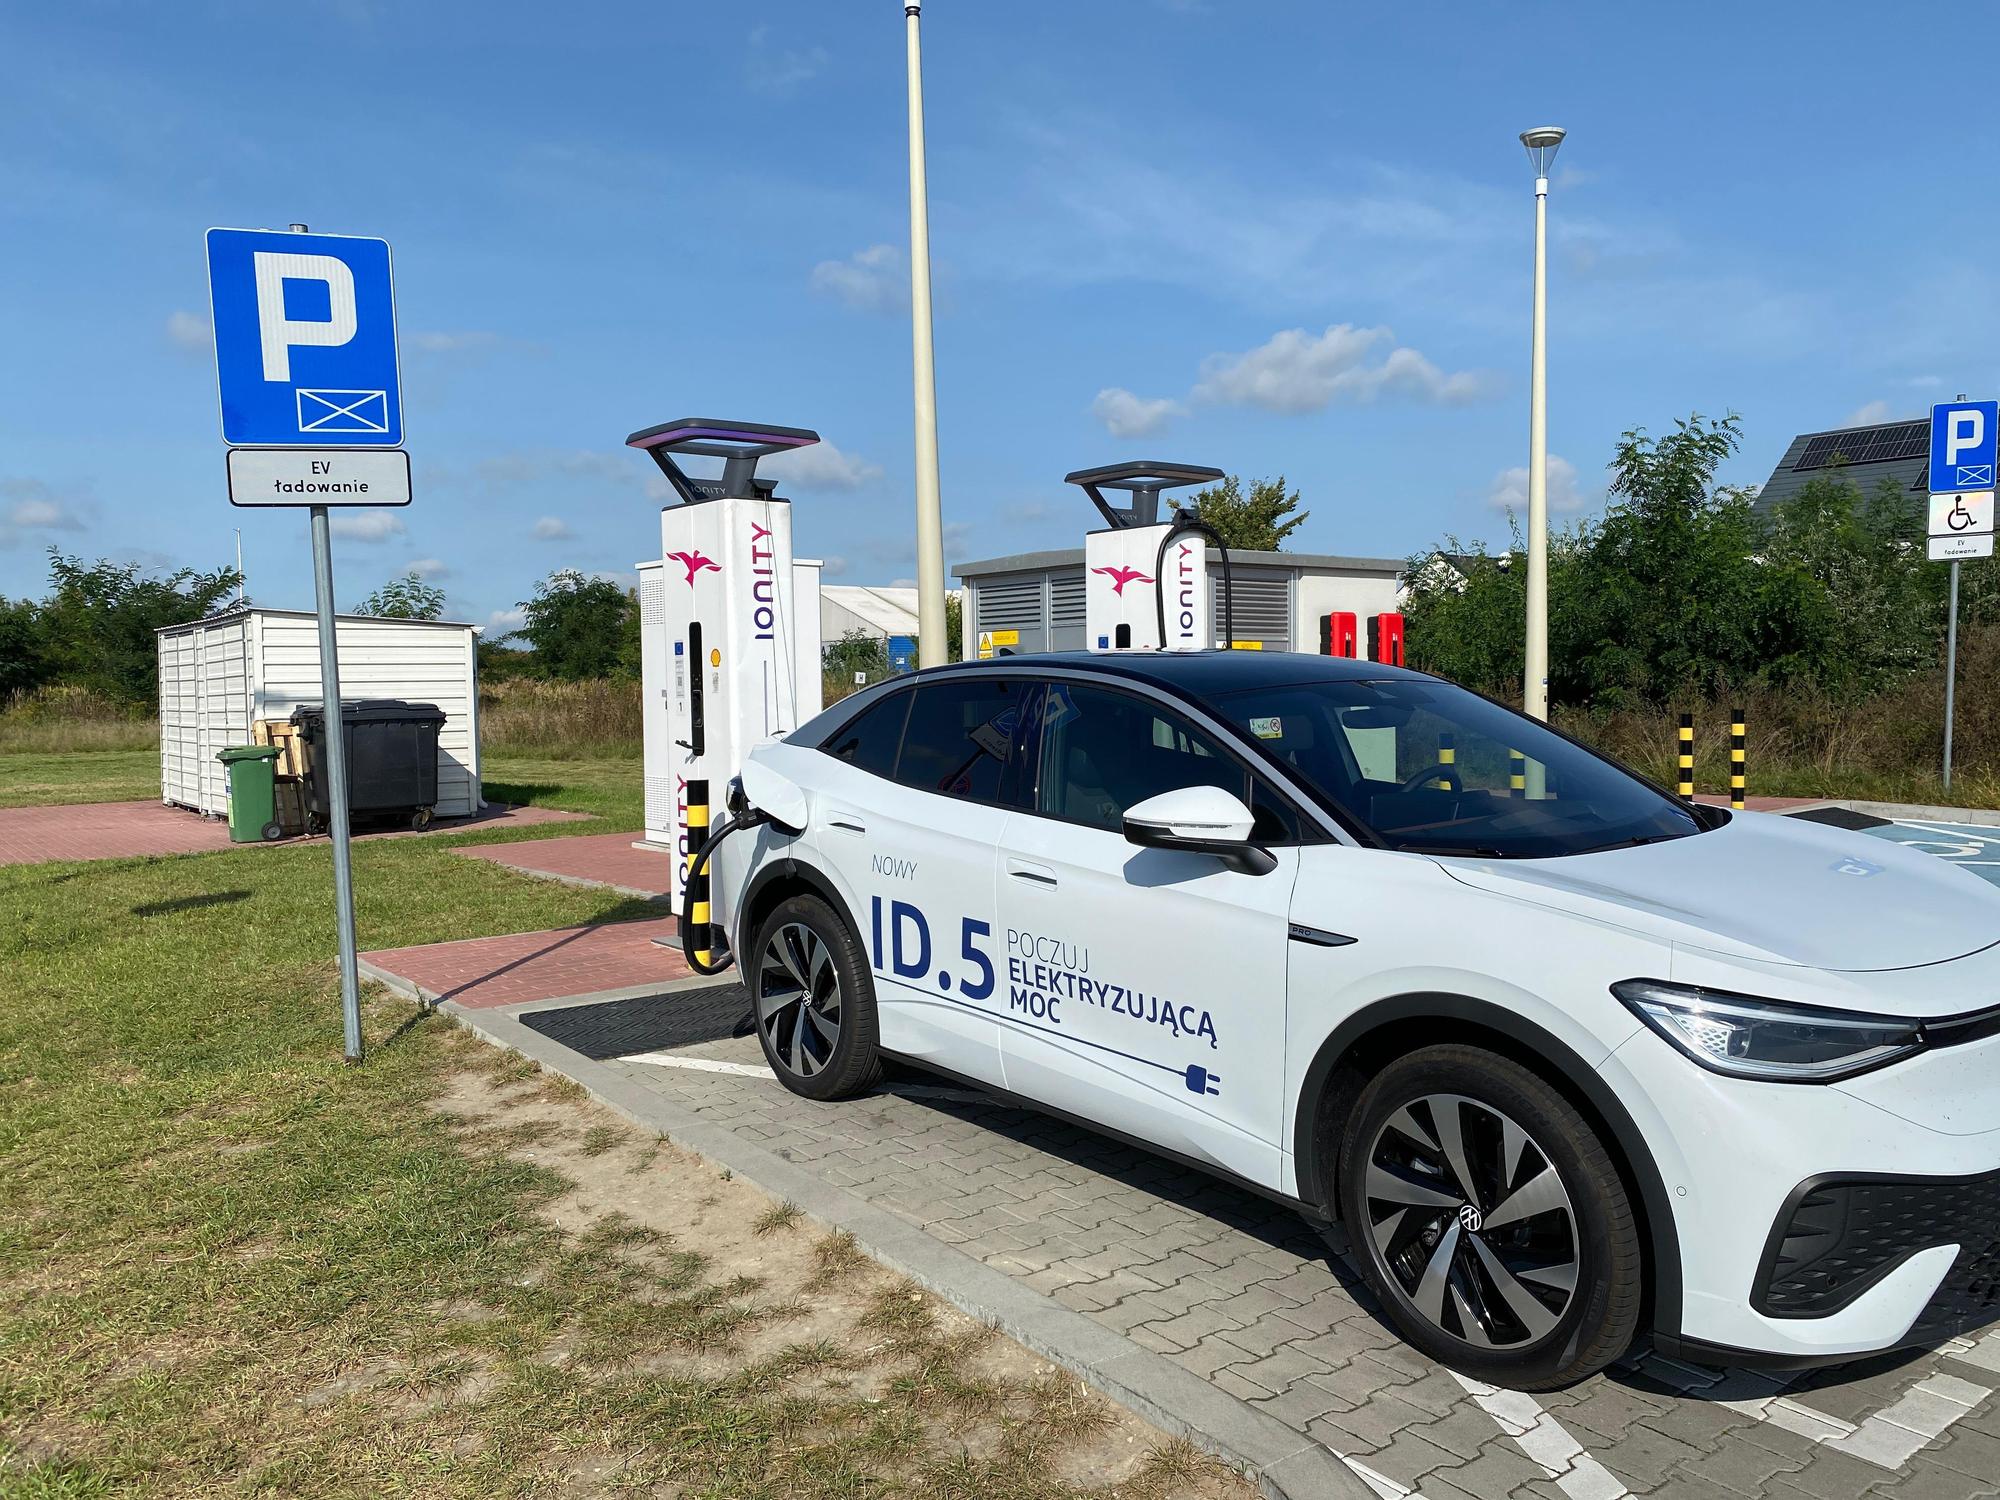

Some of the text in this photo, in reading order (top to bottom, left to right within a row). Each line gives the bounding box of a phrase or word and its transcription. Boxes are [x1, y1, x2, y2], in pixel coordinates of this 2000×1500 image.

[254, 252, 358, 382] P
[1946, 410, 1985, 466] P
[274, 480, 369, 493] ładowanie
[312, 461, 331, 474] EV
[691, 485, 726, 495] IONITY
[751, 521, 774, 640] IONITY
[1179, 543, 1193, 638] IONITY
[872, 853, 919, 881] NOWY
[871, 895, 996, 1000] ID.5
[1007, 928, 1090, 973] POCZUJ
[1292, 926, 1312, 937] PRO
[1008, 958, 1218, 1050] ELEKTRYZUJĄCĄ
[1010, 985, 1061, 1024] MOC
